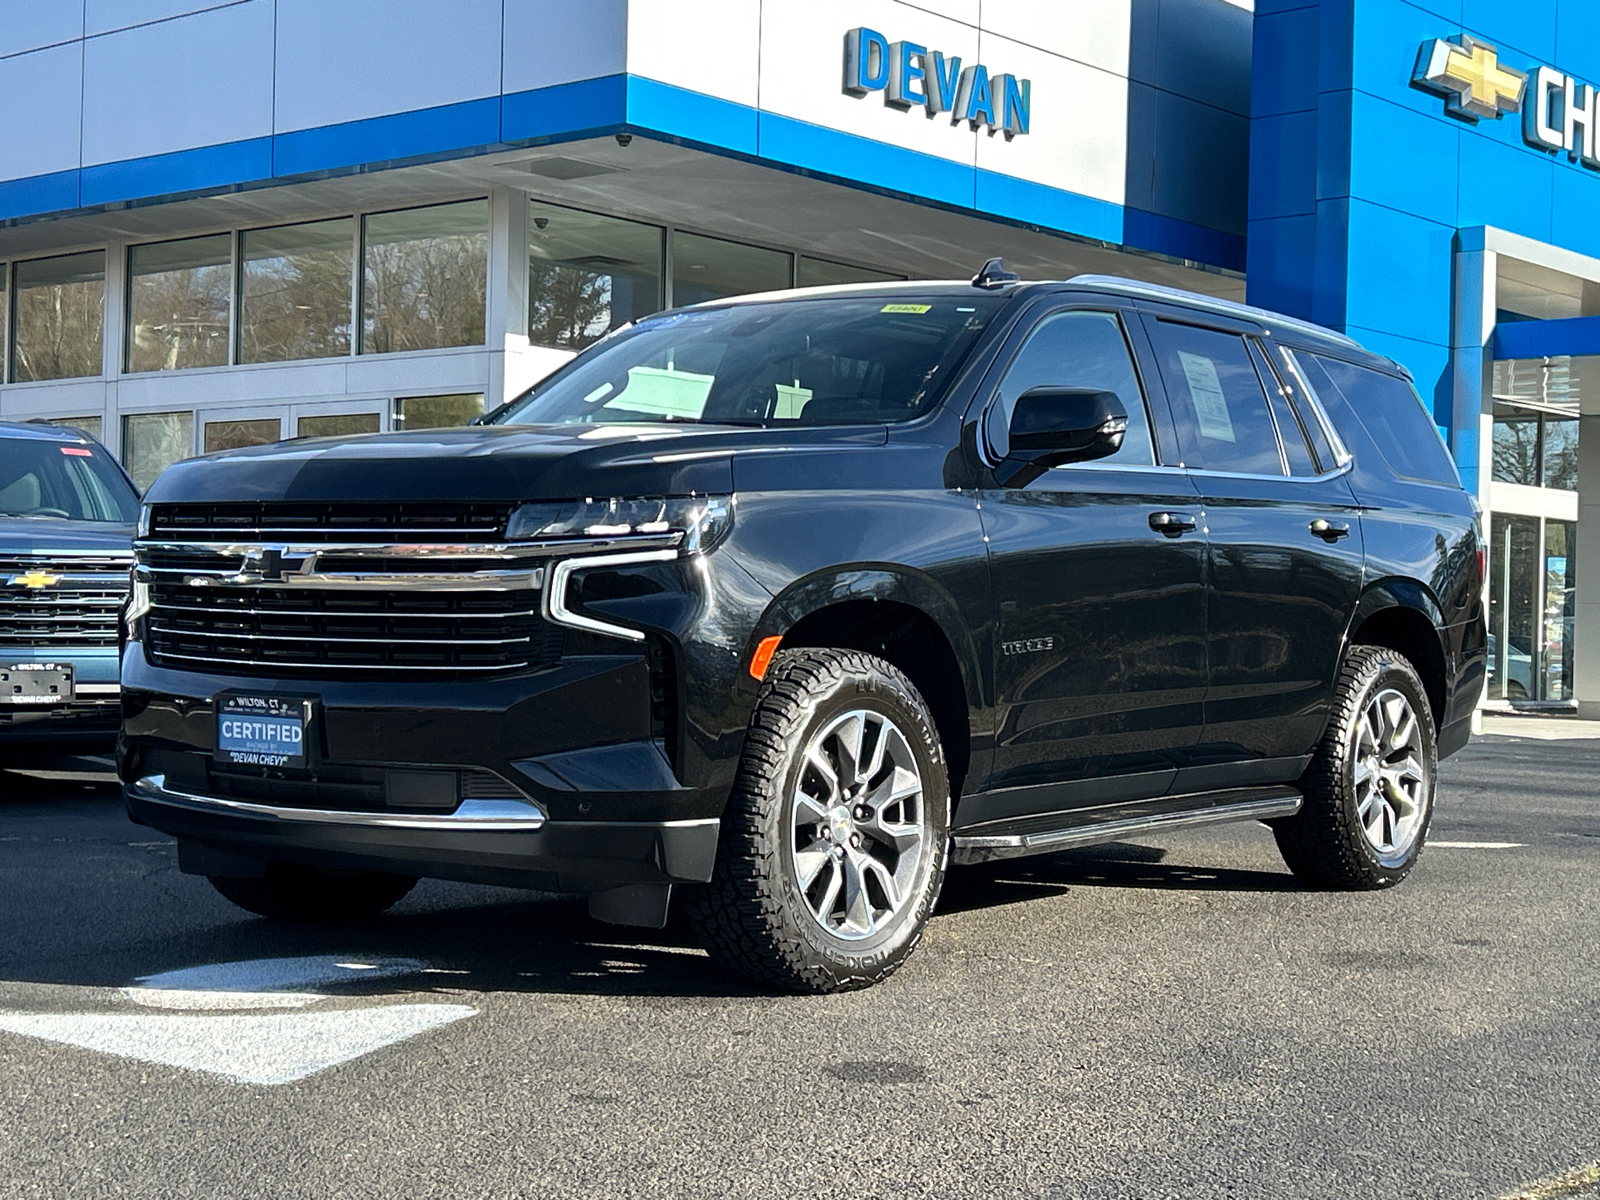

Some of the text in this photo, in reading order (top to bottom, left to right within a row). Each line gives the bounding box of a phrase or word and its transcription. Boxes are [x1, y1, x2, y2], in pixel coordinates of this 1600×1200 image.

[843, 27, 1031, 138] DEVAN
[1001, 636, 1054, 656] TAHOE
[269, 698, 279, 709] CT
[222, 721, 303, 743] CERTIFIED
